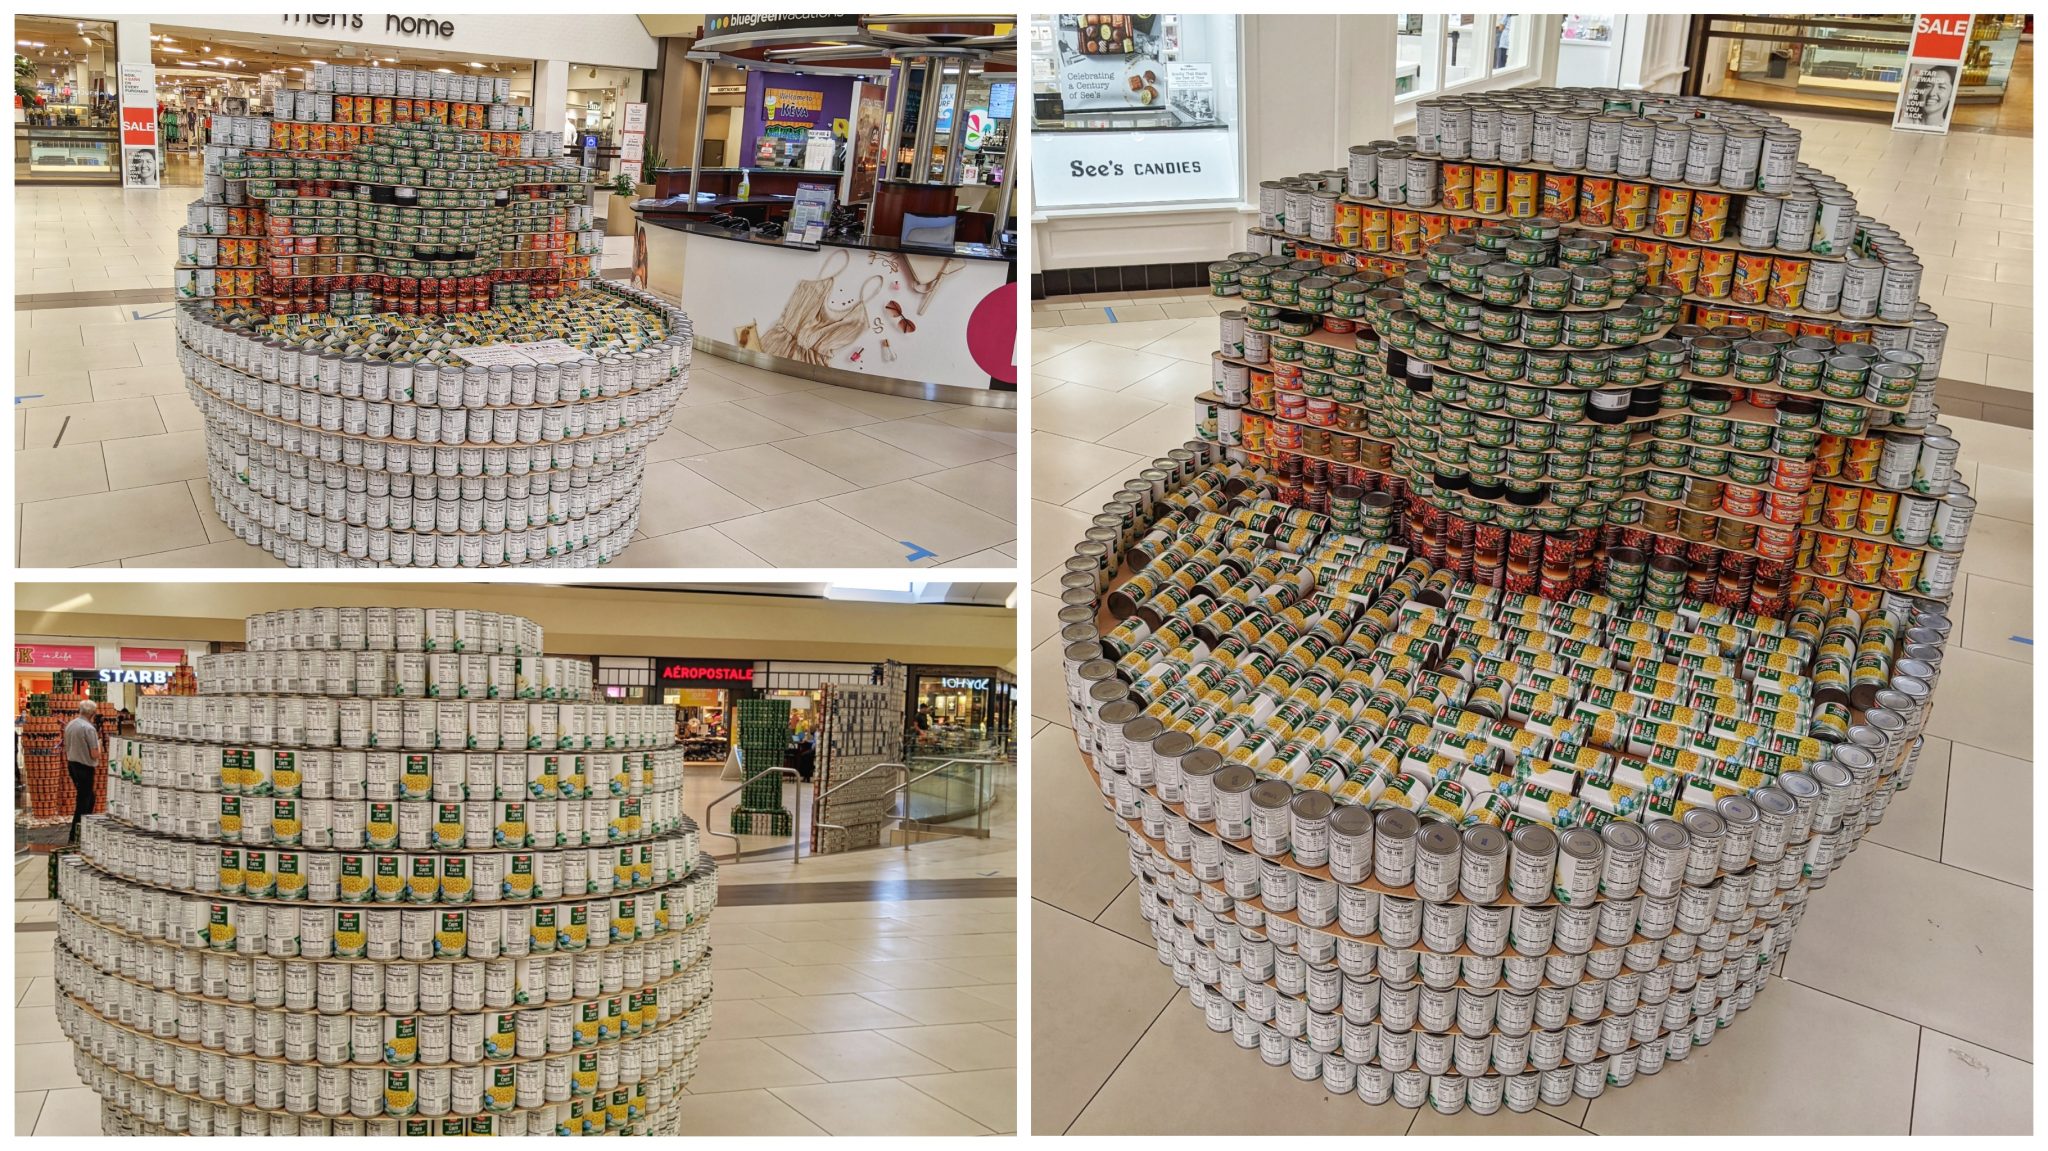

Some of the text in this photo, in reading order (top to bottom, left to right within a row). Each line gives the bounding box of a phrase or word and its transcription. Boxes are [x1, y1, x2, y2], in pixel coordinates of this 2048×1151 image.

[1918, 18, 1968, 36] SALE
[1067, 72, 1115, 81] Celebrating
[1076, 82, 1110, 90] Century
[1080, 91, 1101, 99] See's
[124, 122, 154, 131] SALE
[1070, 160, 1202, 177] See's CANDIES
[100, 669, 172, 684] STARB
[663, 665, 753, 679] AÉROPOSTALE
[1443, 790, 1457, 800] Corn
